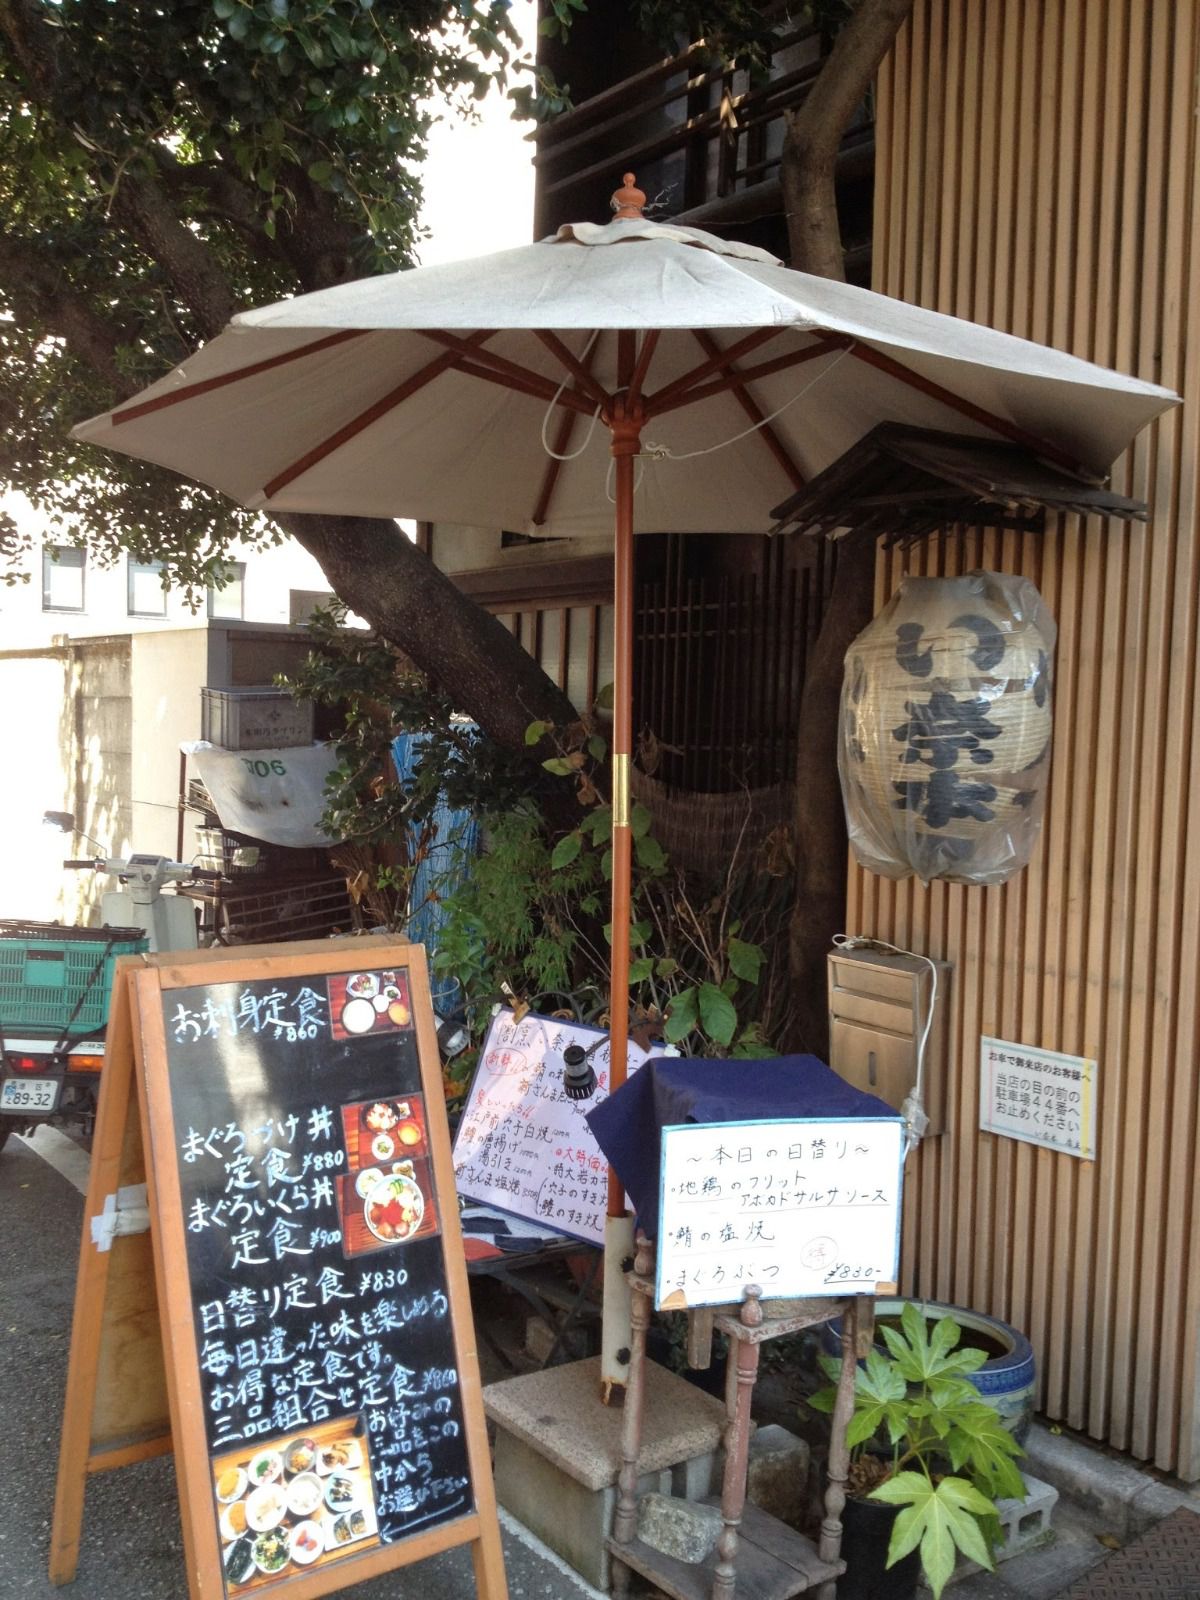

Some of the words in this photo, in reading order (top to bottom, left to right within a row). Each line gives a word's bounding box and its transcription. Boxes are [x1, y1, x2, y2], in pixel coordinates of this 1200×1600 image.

[170, 987, 326, 1043] お刺身定食
[996, 1073, 1081, 1104] 当店の目の前の
[996, 1102, 1081, 1132] お止めください
[225, 1147, 303, 1193] 定食
[231, 1217, 314, 1269] 定食
[200, 1267, 355, 1333] 日替り定食
[374, 1453, 434, 1492] 中から
